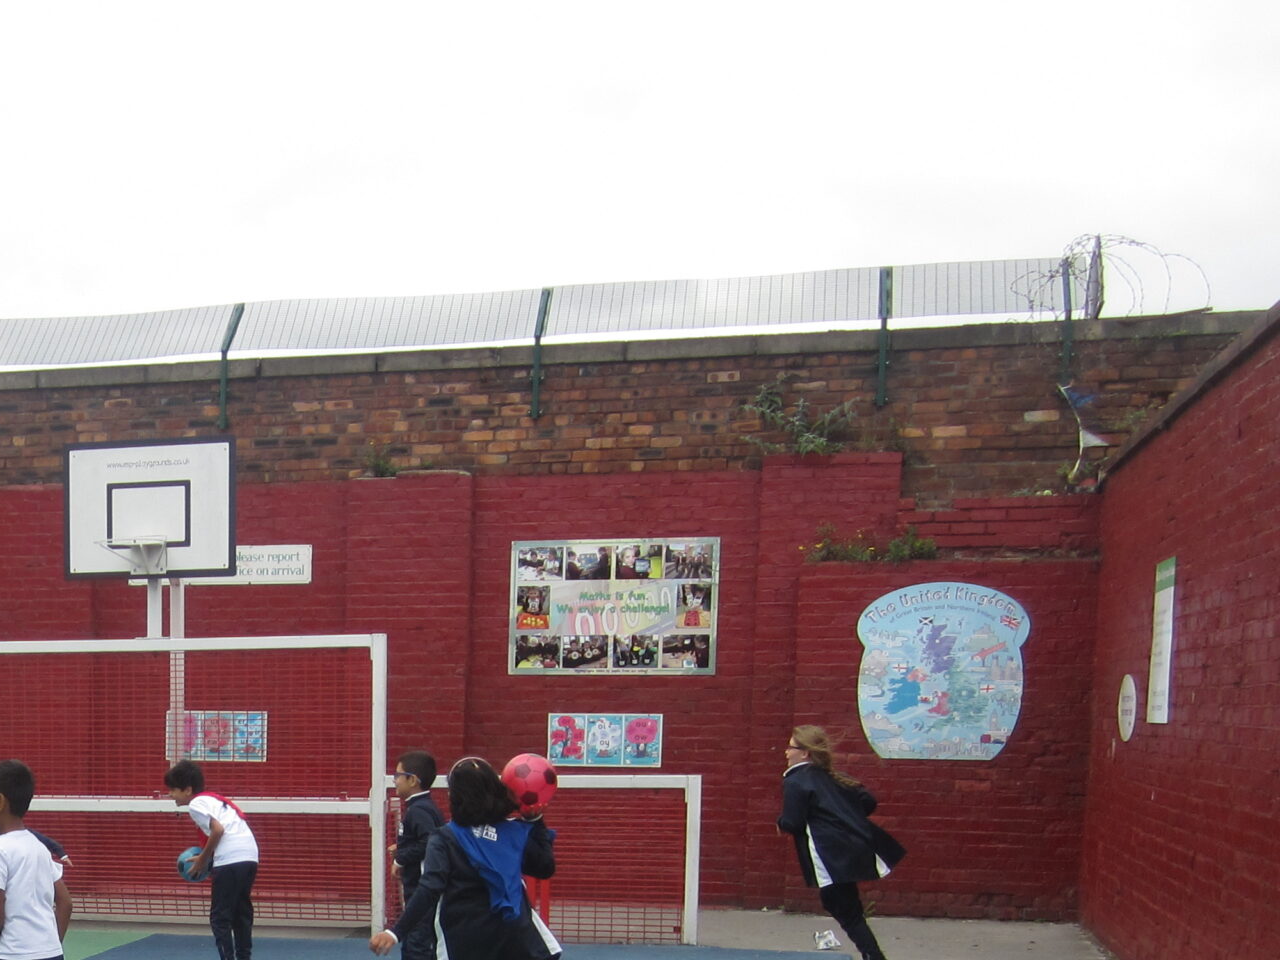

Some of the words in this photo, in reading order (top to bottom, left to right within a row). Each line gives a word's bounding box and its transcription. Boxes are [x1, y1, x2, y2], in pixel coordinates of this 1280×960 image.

[267, 552, 299, 563] report
[256, 568, 269, 576] on
[271, 564, 304, 576] arrival
[579, 591, 611, 601] Maths
[556, 603, 574, 613] We
[578, 605, 605, 616] enjoy
[609, 605, 616, 613] a
[621, 603, 670, 615] challenge!
[864, 602, 897, 624] The
[899, 587, 951, 608] United
[955, 586, 1016, 616] Kingdom
